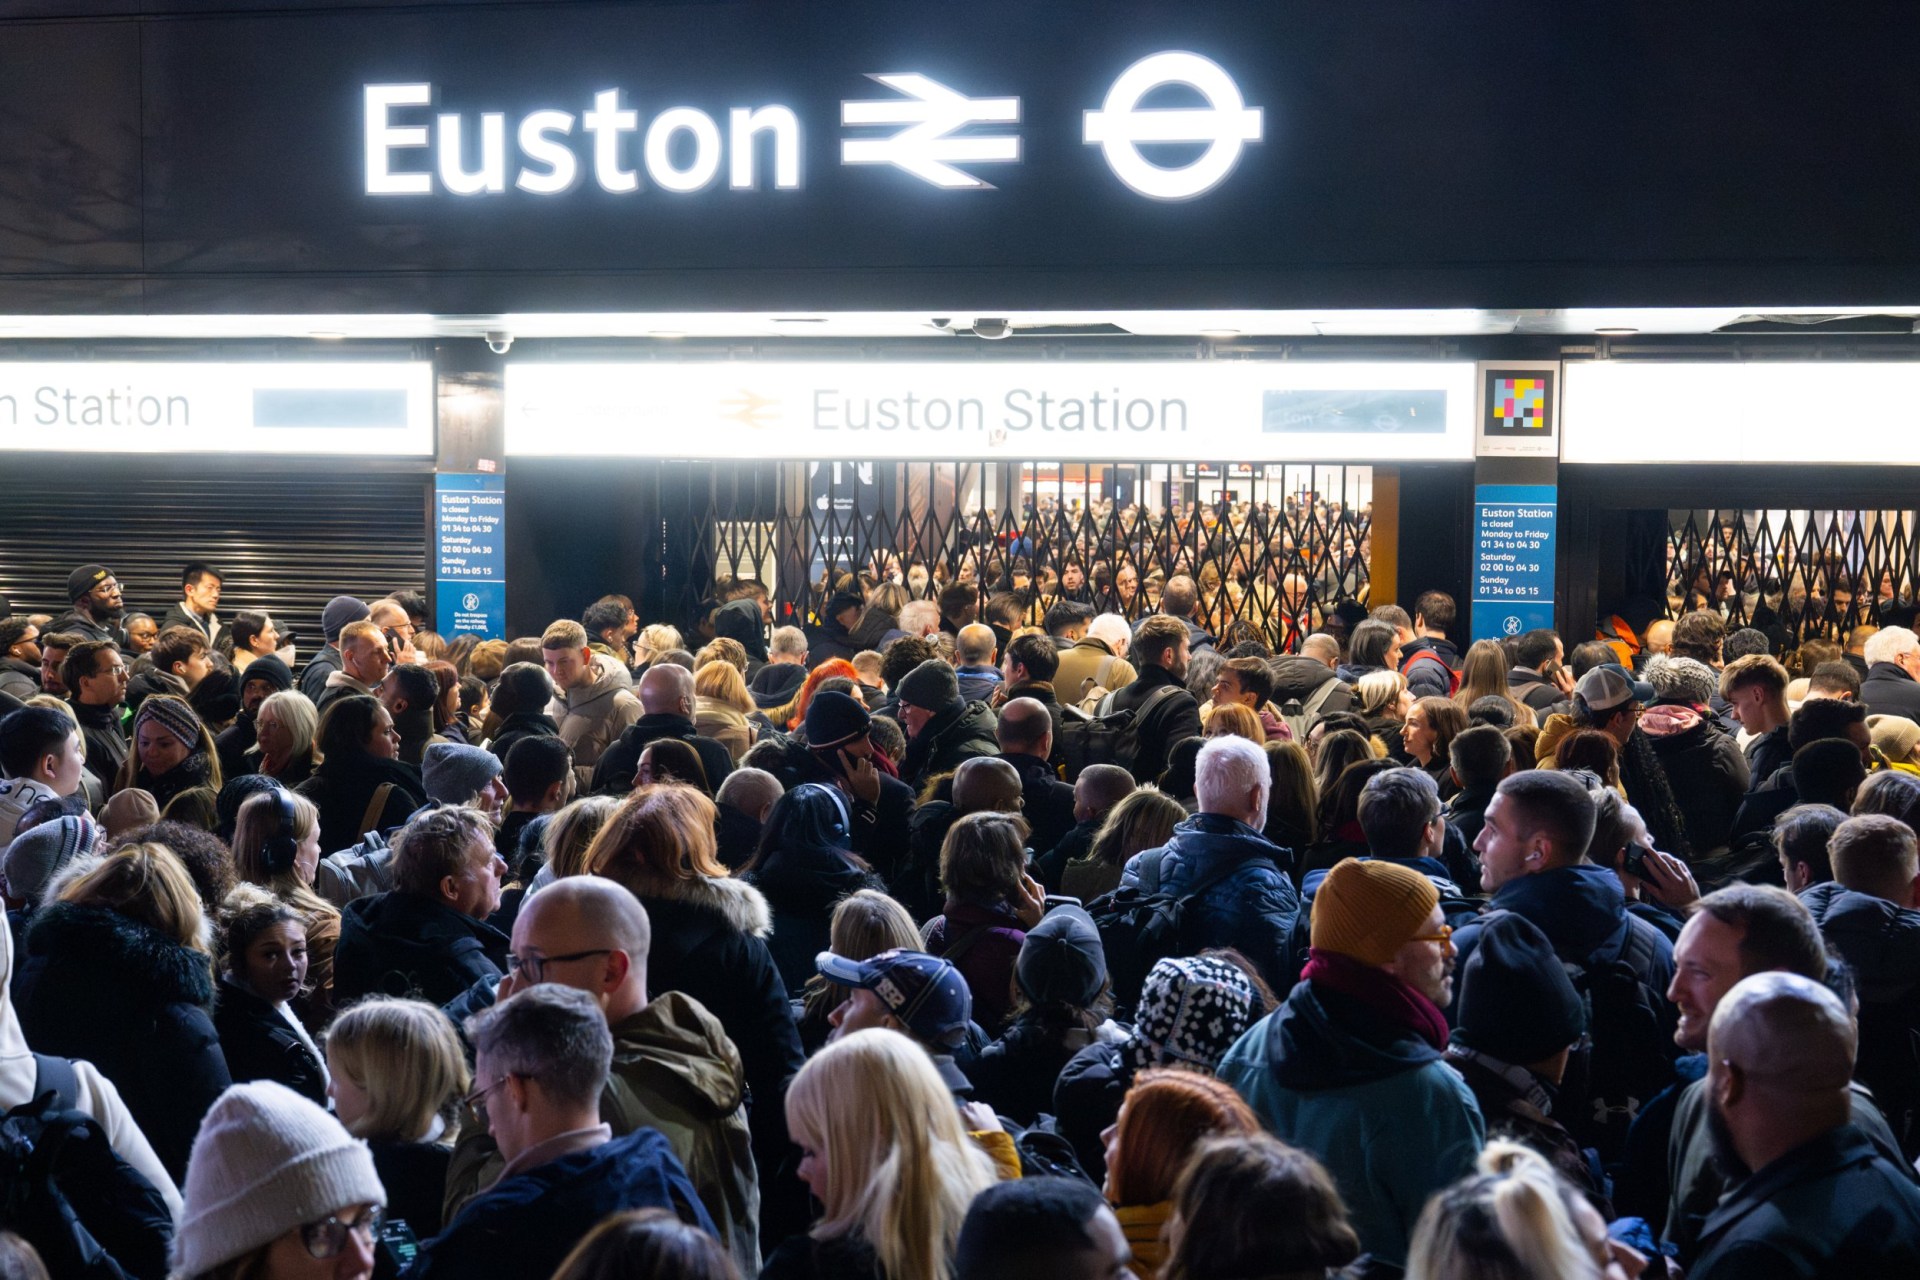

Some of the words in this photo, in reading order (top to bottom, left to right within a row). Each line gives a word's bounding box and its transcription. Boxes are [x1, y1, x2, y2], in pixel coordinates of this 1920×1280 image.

[363, 82, 802, 196] Euston
[34, 385, 190, 426] Station
[812, 389, 984, 432] Euston
[1003, 387, 1188, 432] Station
[442, 495, 470, 504] Euston
[472, 496, 502, 504] Station
[1482, 508, 1515, 518] Euston
[1517, 508, 1553, 518] Station
[442, 515, 468, 524] Monday
[478, 516, 500, 525] Friday
[1489, 520, 1514, 528] closed
[1481, 530, 1513, 539] Monday
[1524, 530, 1549, 540] Friday
[442, 536, 472, 545] Saturday
[1529, 541, 1540, 549] 30
[442, 557, 466, 566] Sunday
[1481, 553, 1516, 562] Saturday
[1480, 576, 1509, 585] Sunday
